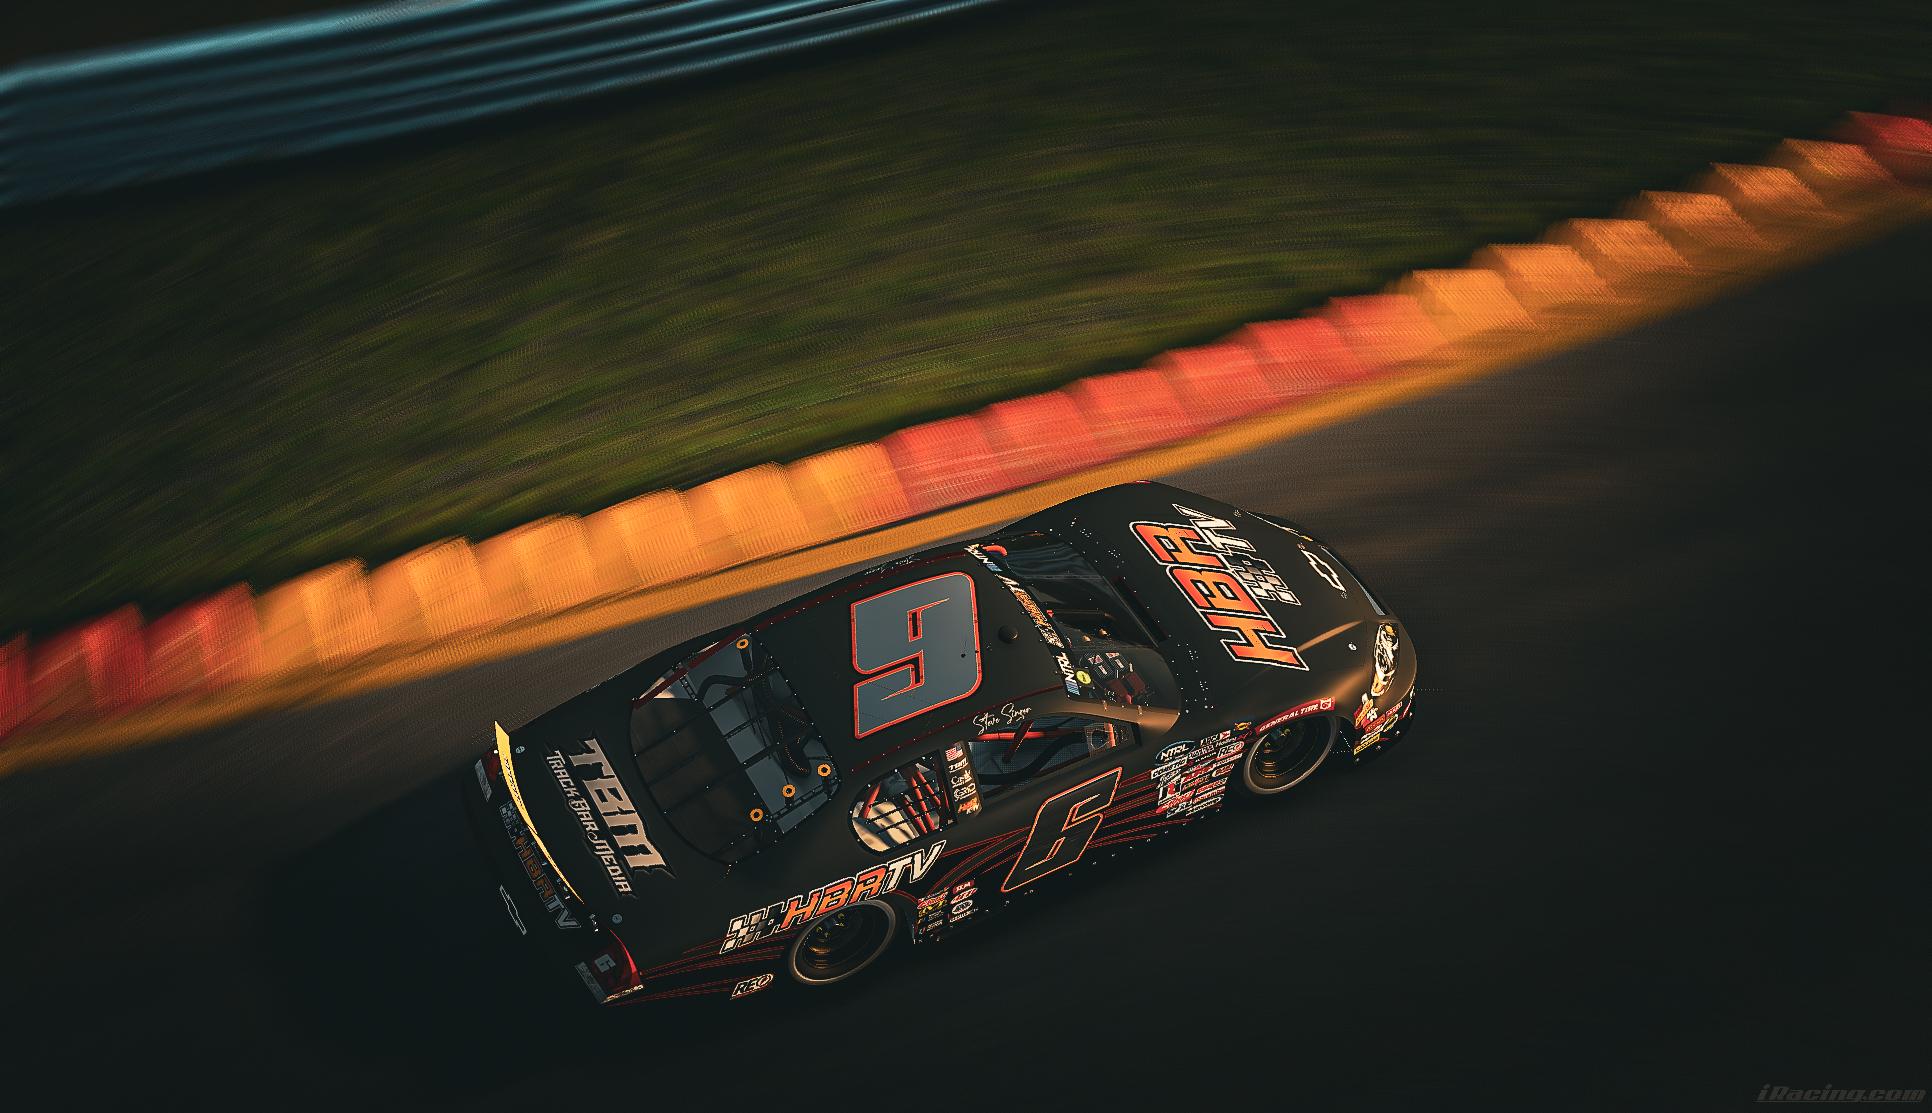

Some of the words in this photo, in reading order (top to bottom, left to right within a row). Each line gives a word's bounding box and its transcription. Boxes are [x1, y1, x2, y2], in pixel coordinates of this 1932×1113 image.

[1300, 703, 1319, 715] TIRE
[546, 750, 580, 798] TRACK
[1160, 743, 1189, 761] NTRL
[568, 737, 667, 868] TBM
[1000, 766, 1123, 893] 6
[779, 840, 947, 929] HBRTV
